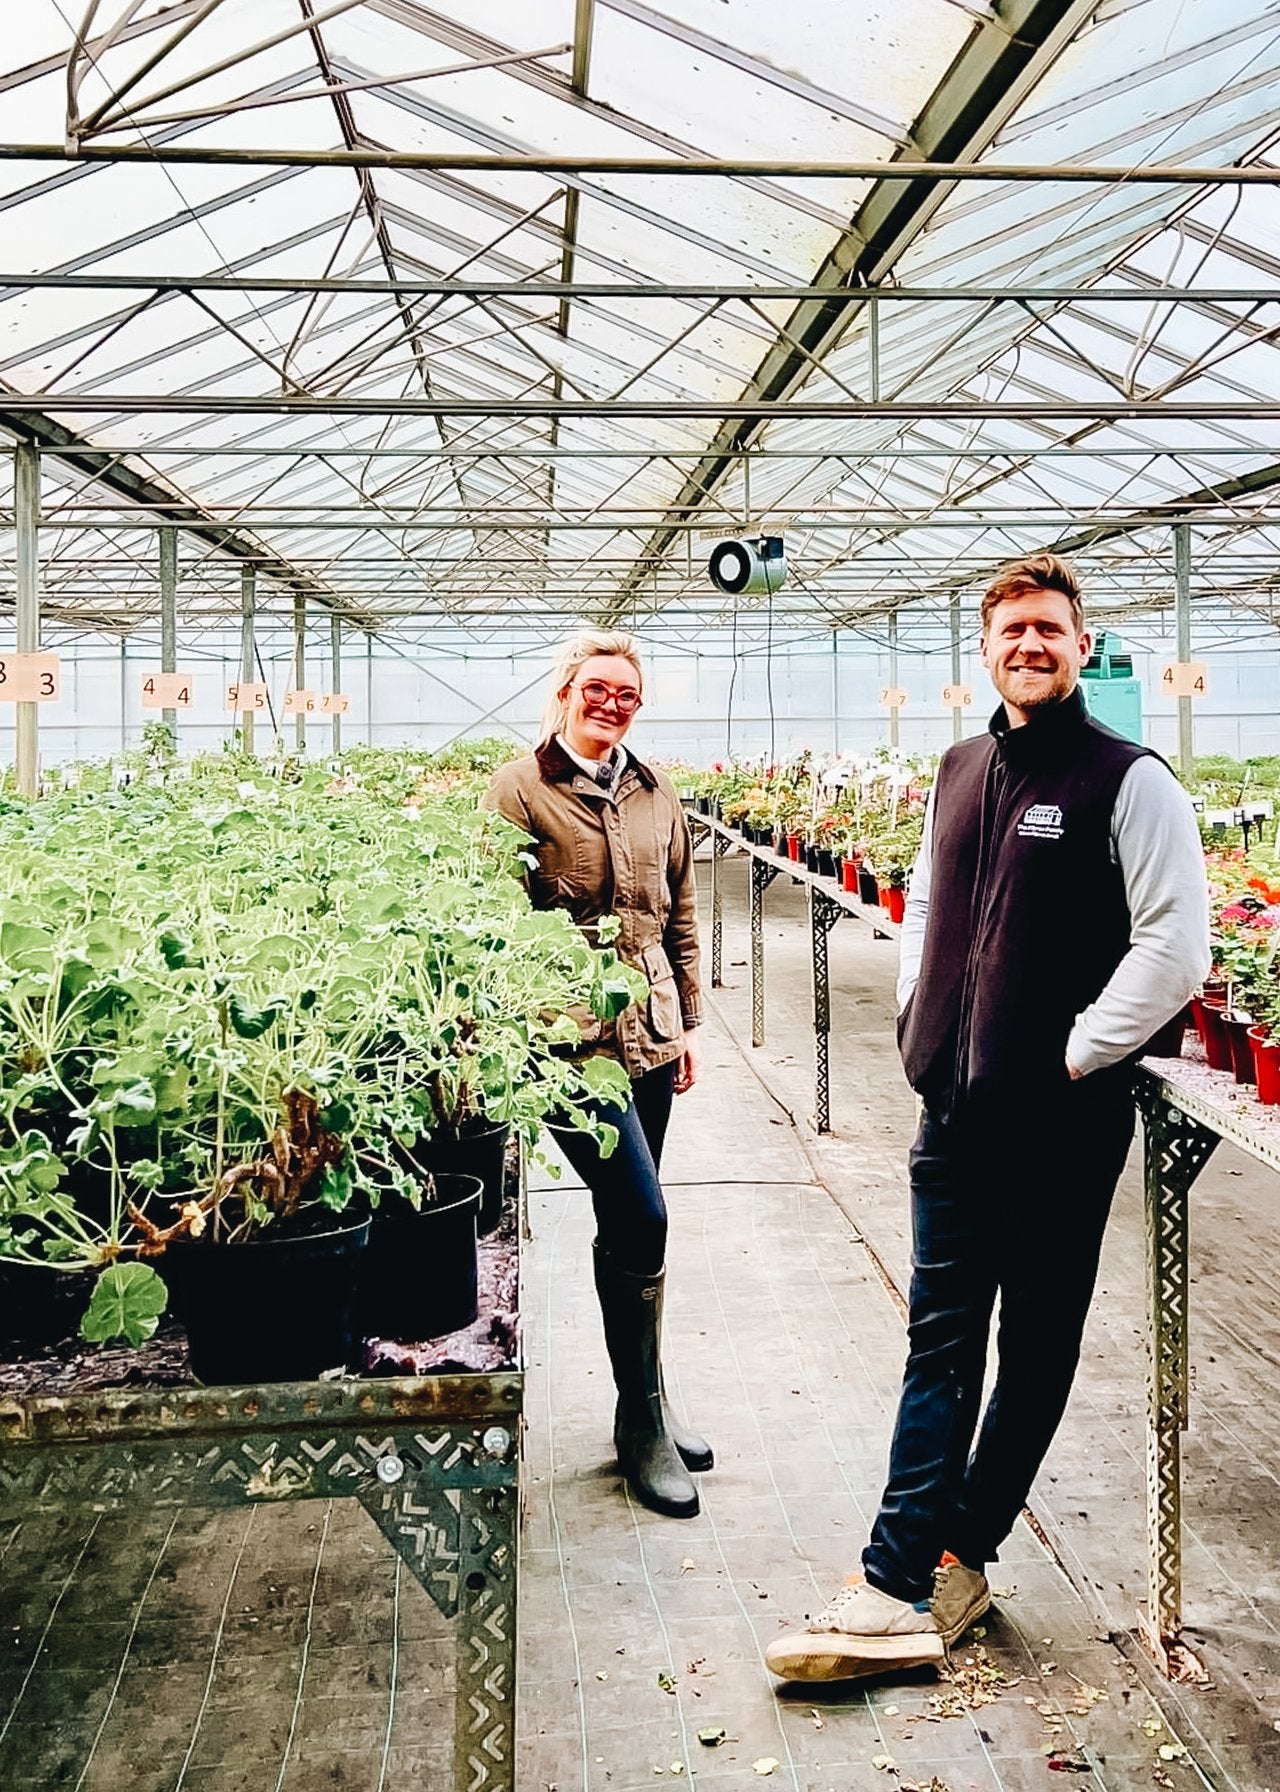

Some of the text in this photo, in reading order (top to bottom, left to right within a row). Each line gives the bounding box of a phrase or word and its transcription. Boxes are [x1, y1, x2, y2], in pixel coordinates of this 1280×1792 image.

[40, 672, 55, 696] 3
[1163, 667, 1205, 692] 4 4
[143, 678, 190, 704] 4 4
[227, 687, 264, 707] 5 5
[899, 695, 906, 705] 7
[943, 688, 971, 705] 6 6
[306, 699, 314, 711] 6
[323, 696, 348, 711] 7 7
